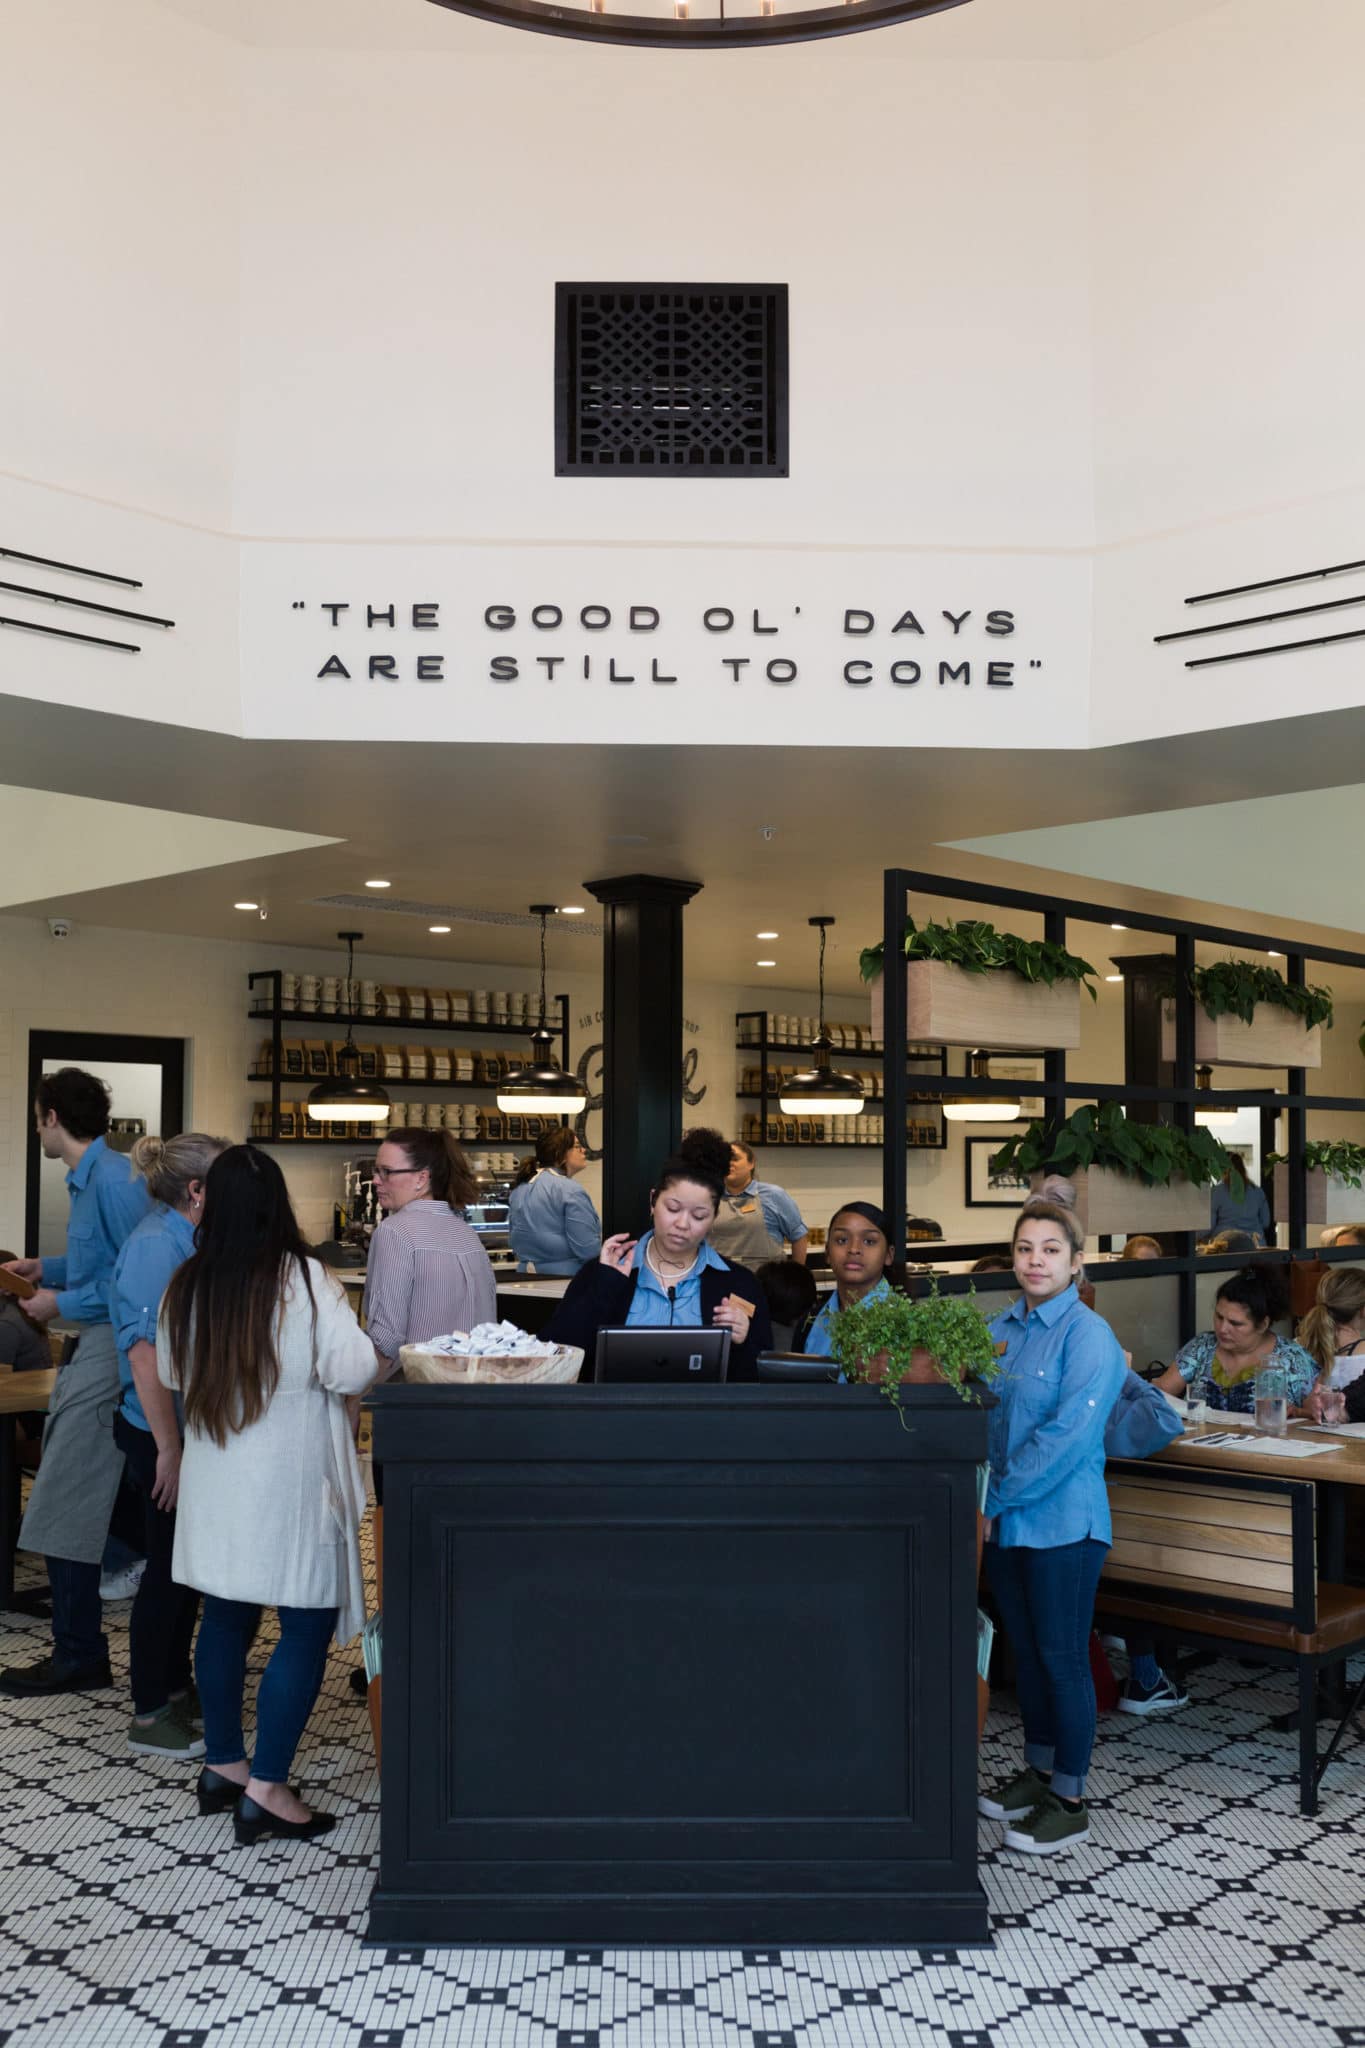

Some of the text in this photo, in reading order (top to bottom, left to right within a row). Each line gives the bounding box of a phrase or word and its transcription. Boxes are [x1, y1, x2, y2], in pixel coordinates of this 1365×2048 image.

[292, 601, 1015, 636] "THE GOOD OL' DAYS
[316, 654, 1042, 687] ARE STILL TO COME"
